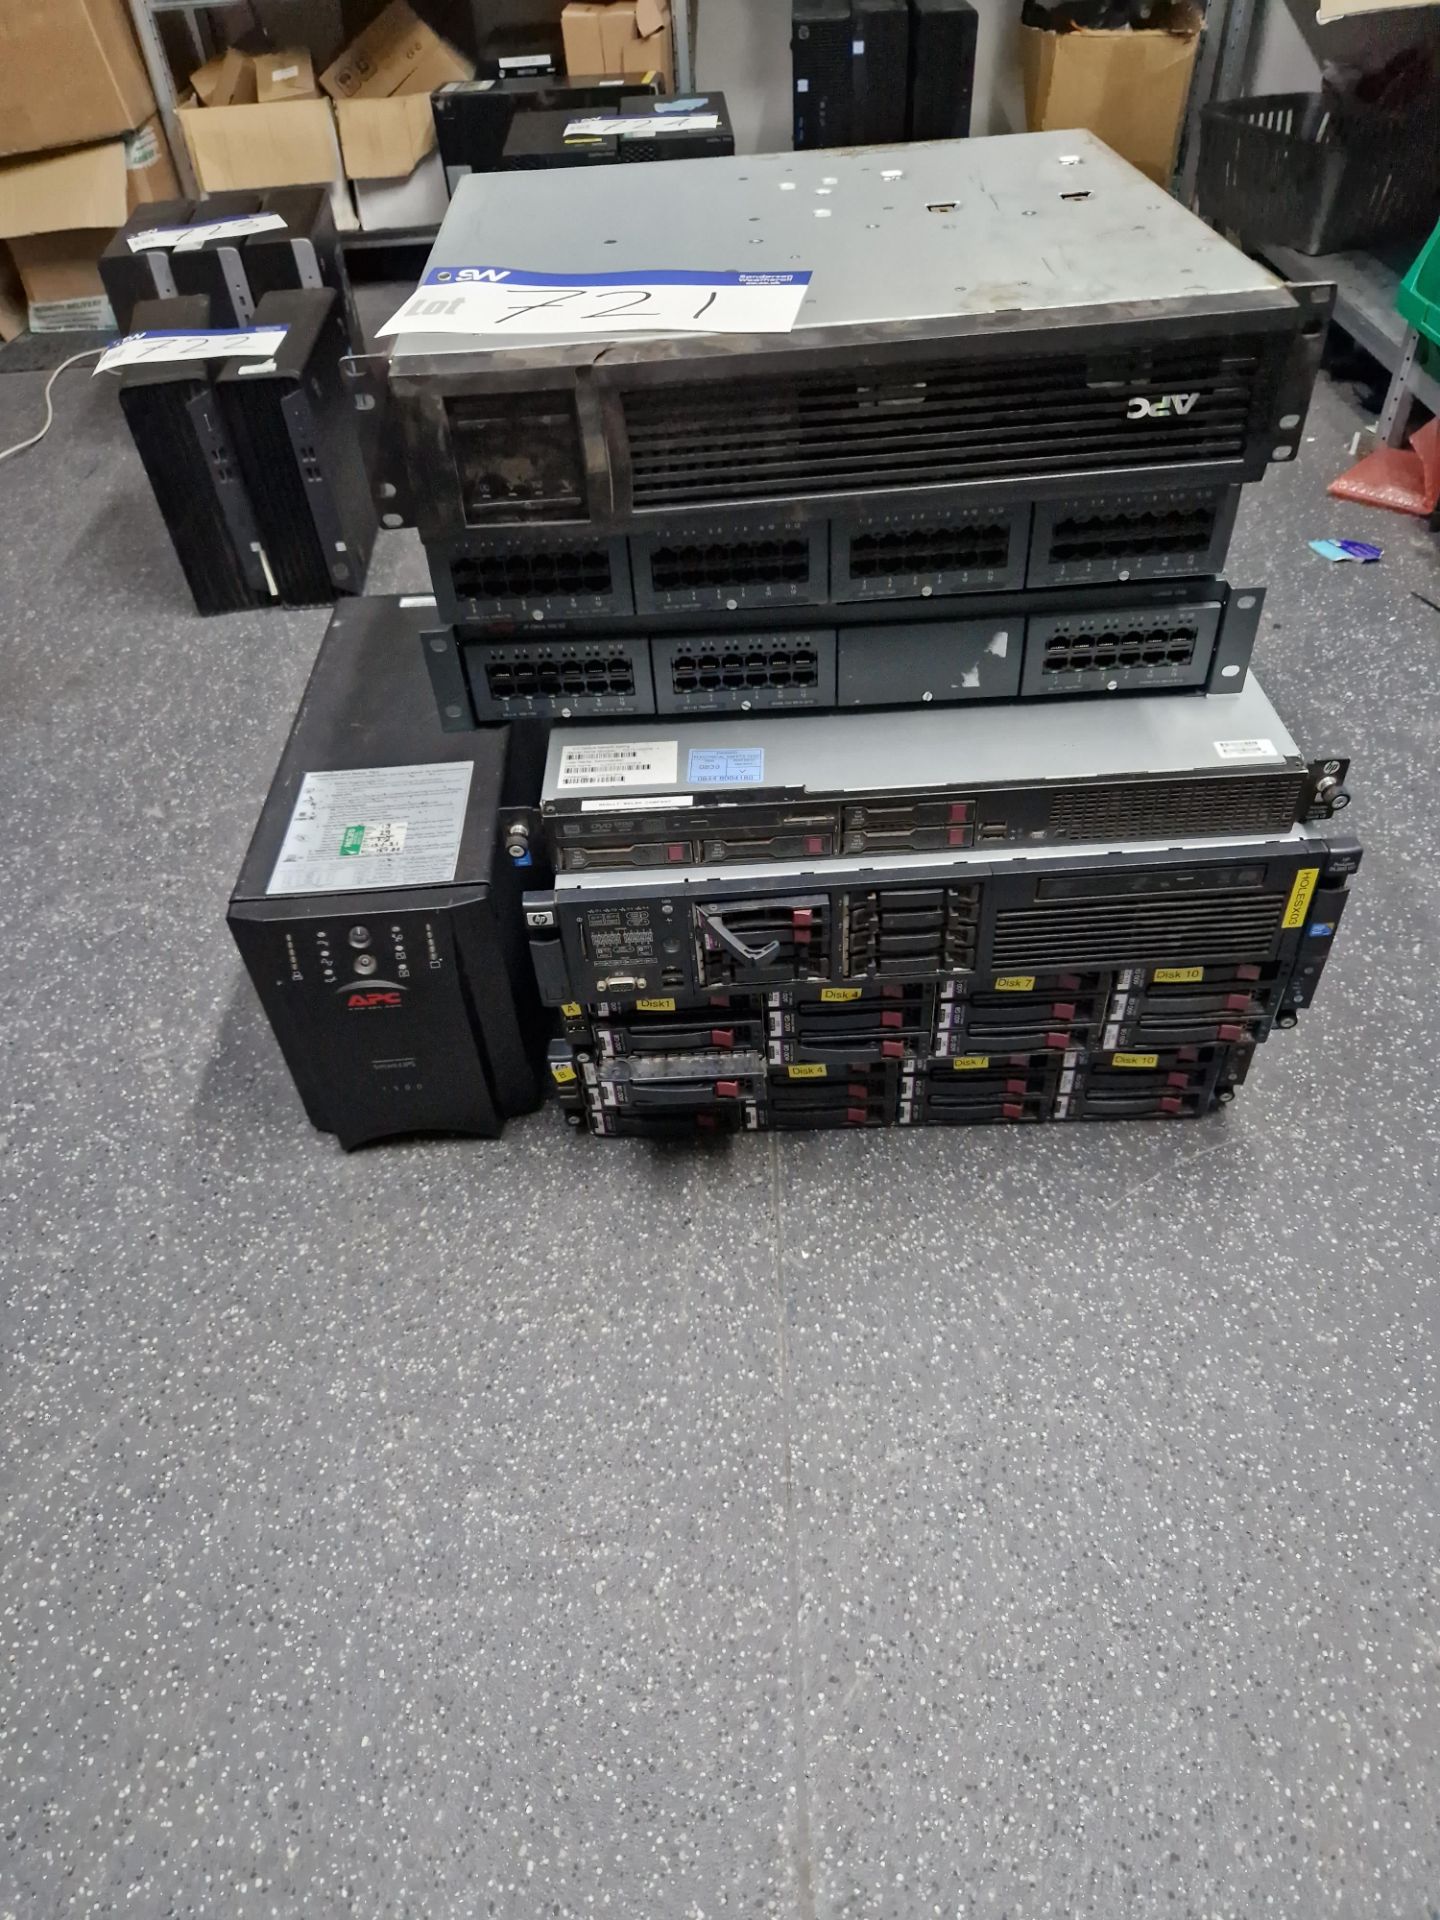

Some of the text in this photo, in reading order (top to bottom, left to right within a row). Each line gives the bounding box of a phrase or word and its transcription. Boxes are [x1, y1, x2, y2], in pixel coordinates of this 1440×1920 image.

[404, 297, 465, 317] Lot
[494, 289, 718, 324] 721
[1126, 392, 1200, 420] APC
[1156, 969, 1200, 979] Disk 10
[998, 978, 1032, 987] Disk 7
[825, 990, 849, 999] Disk
[347, 992, 401, 1007] APC
[954, 1059, 976, 1067] Disk
[1115, 1055, 1155, 1064] Disk 10
[792, 1067, 814, 1075] Disk
